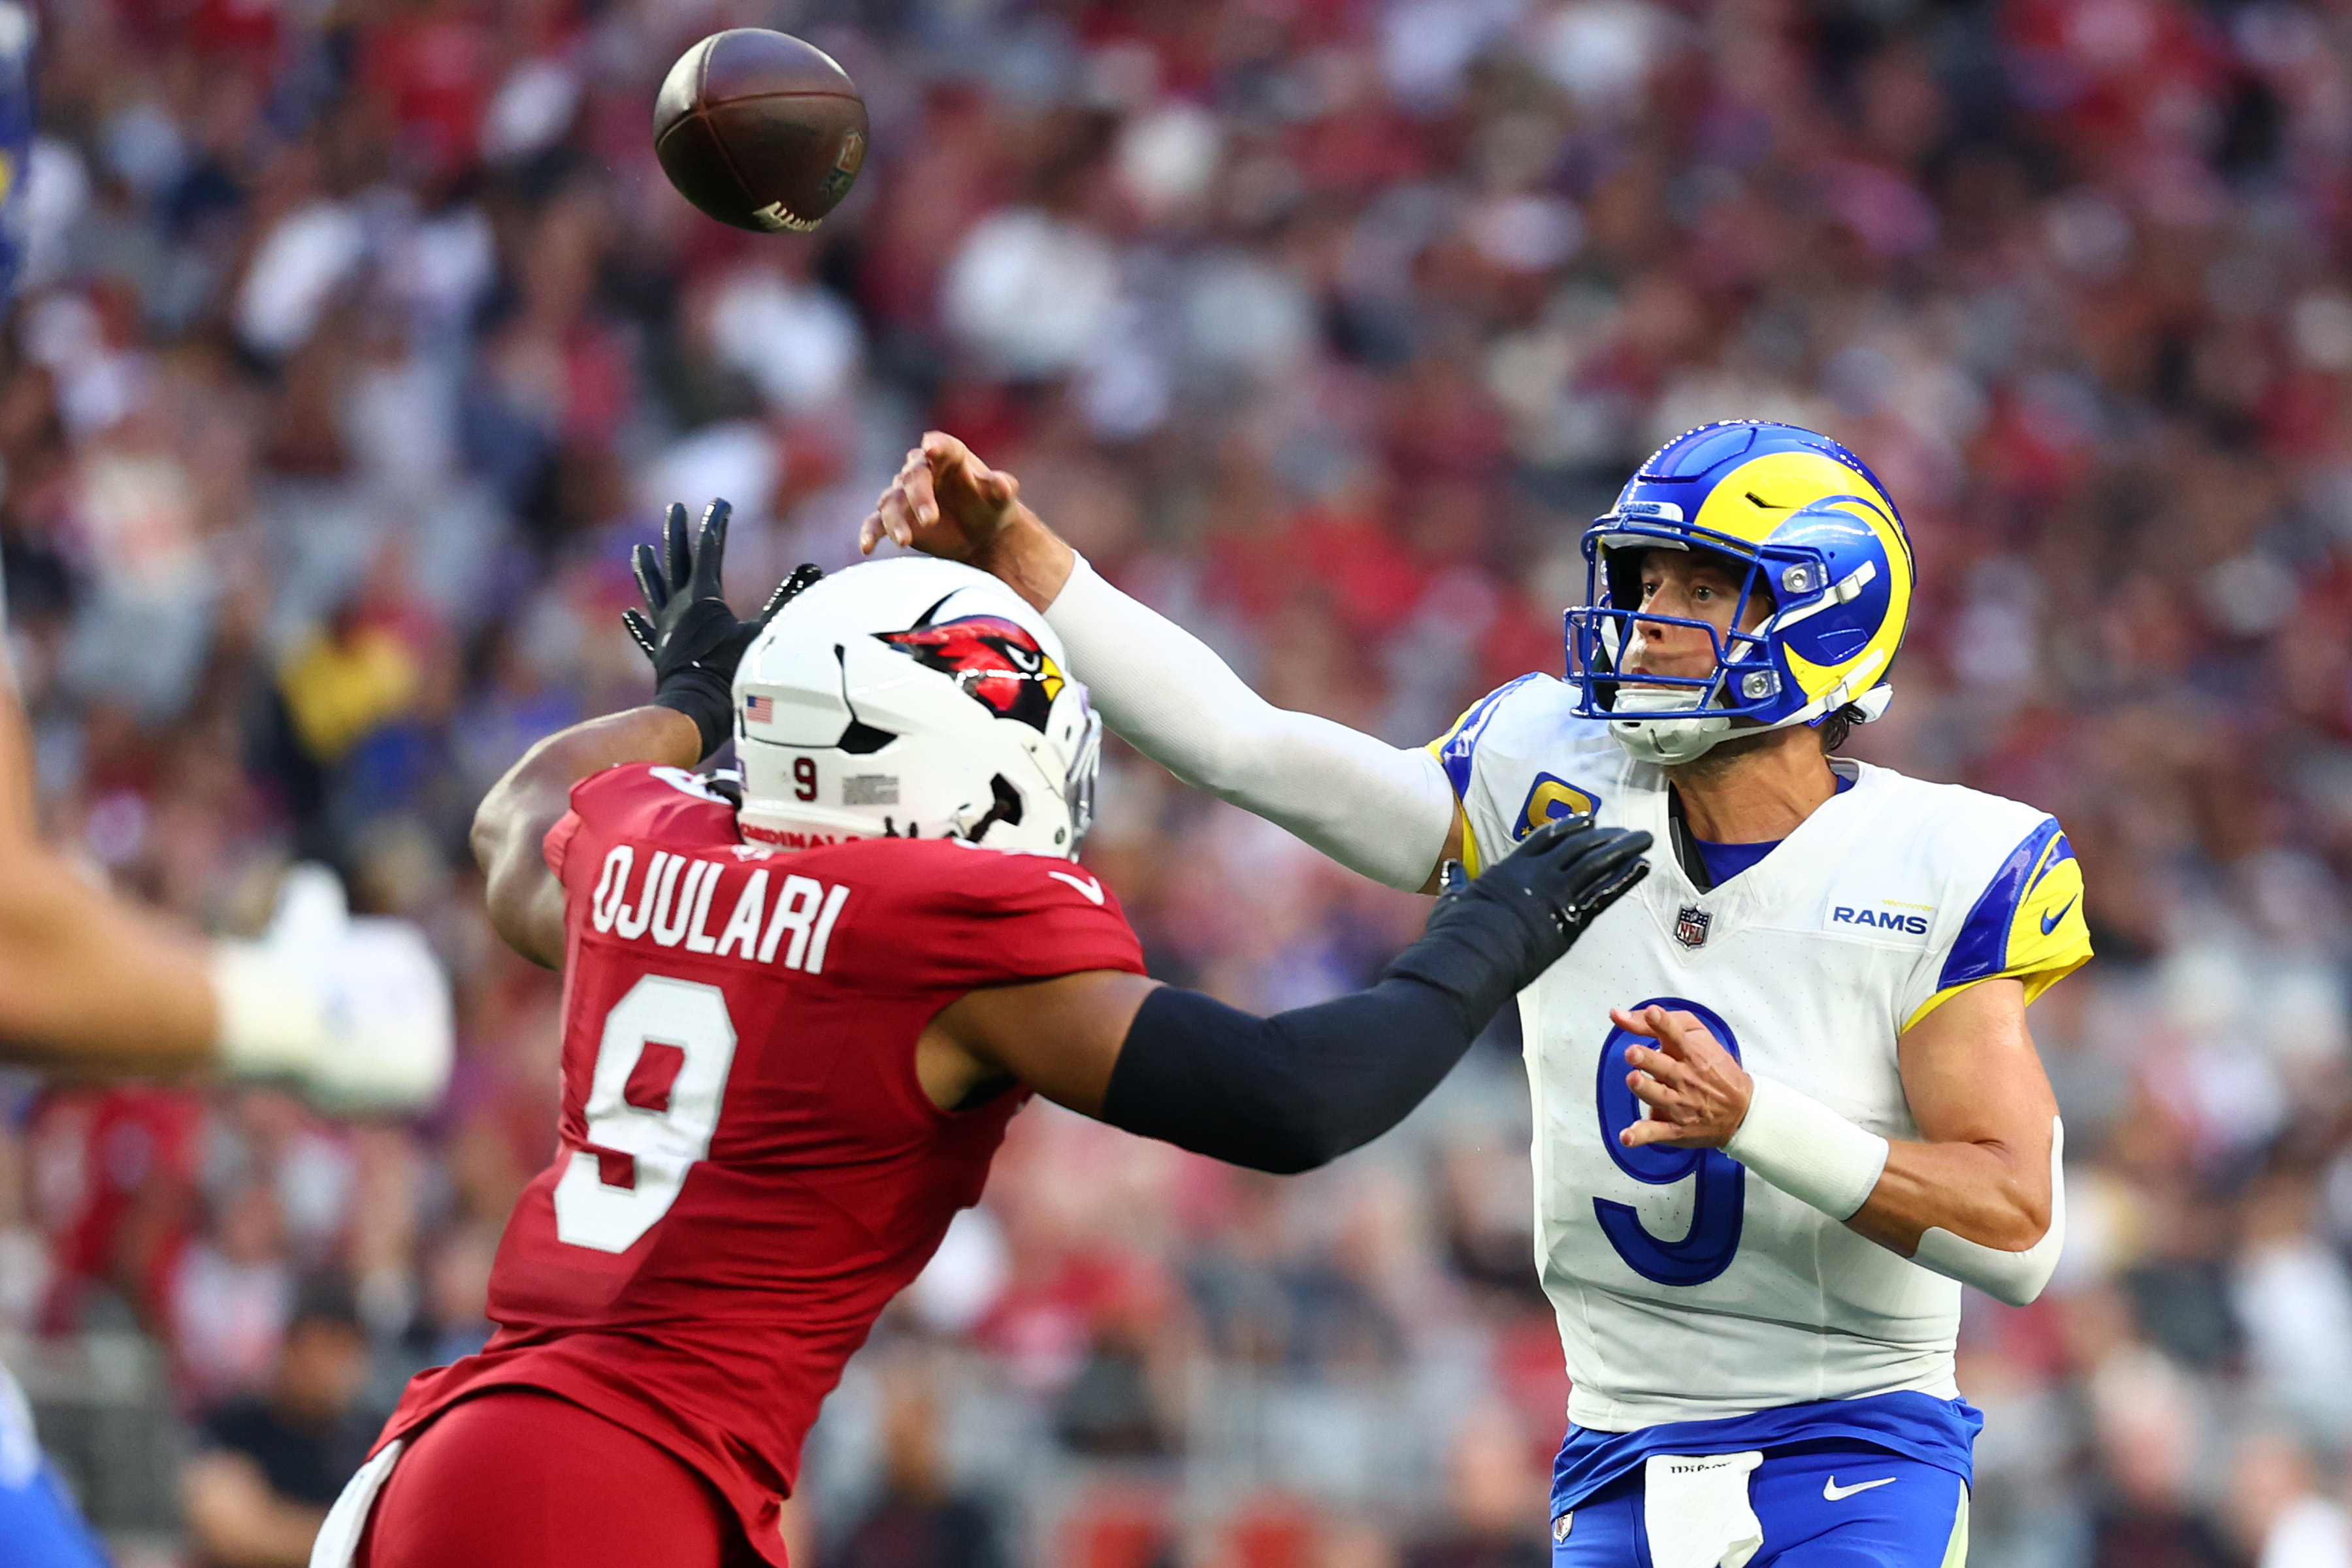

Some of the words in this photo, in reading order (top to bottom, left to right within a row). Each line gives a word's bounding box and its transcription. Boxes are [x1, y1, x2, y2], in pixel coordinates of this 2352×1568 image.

[1618, 503, 1661, 515] RAMS
[794, 757, 817, 802] 9
[593, 845, 851, 975] OJULARI
[1677, 922, 1703, 941] NFL
[1833, 906, 1928, 935] RAMS
[553, 973, 739, 1254] 9
[1593, 997, 1745, 1286] 9
